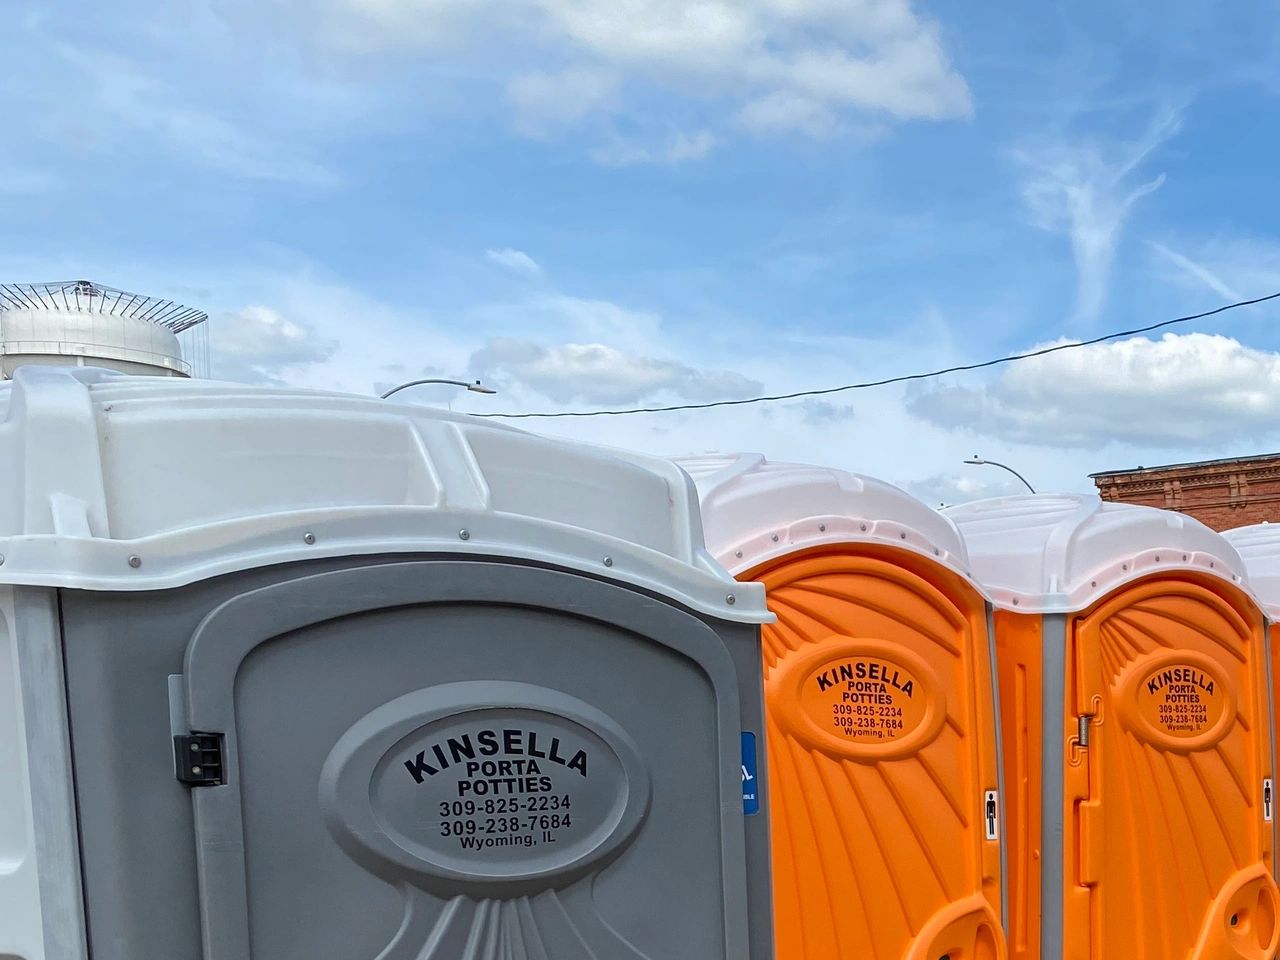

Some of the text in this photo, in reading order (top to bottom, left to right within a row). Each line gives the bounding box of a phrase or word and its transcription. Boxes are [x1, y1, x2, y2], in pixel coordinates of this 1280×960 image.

[816, 662, 913, 698] KINSELLA
[1148, 669, 1214, 695] KINSELLA
[848, 681, 887, 693] PORTA
[1169, 685, 1196, 693] PORTA
[843, 692, 892, 704] POTTIES
[1166, 695, 1199, 703] POTTIES
[833, 704, 902, 717] 309-825-2234
[1159, 705, 1206, 713] 309-825-2234
[834, 717, 903, 729] 309-238-7684
[1160, 715, 1207, 723] 309-238-7684
[844, 727, 885, 738] Wyoming,
[404, 730, 587, 784] KINSELLA
[467, 759, 541, 777] PORTA
[458, 776, 552, 796] POTTIES
[440, 795, 570, 817] 309-825-2234
[440, 814, 571, 836] 309-238-7684
[460, 831, 556, 850] Wyoming, IL
